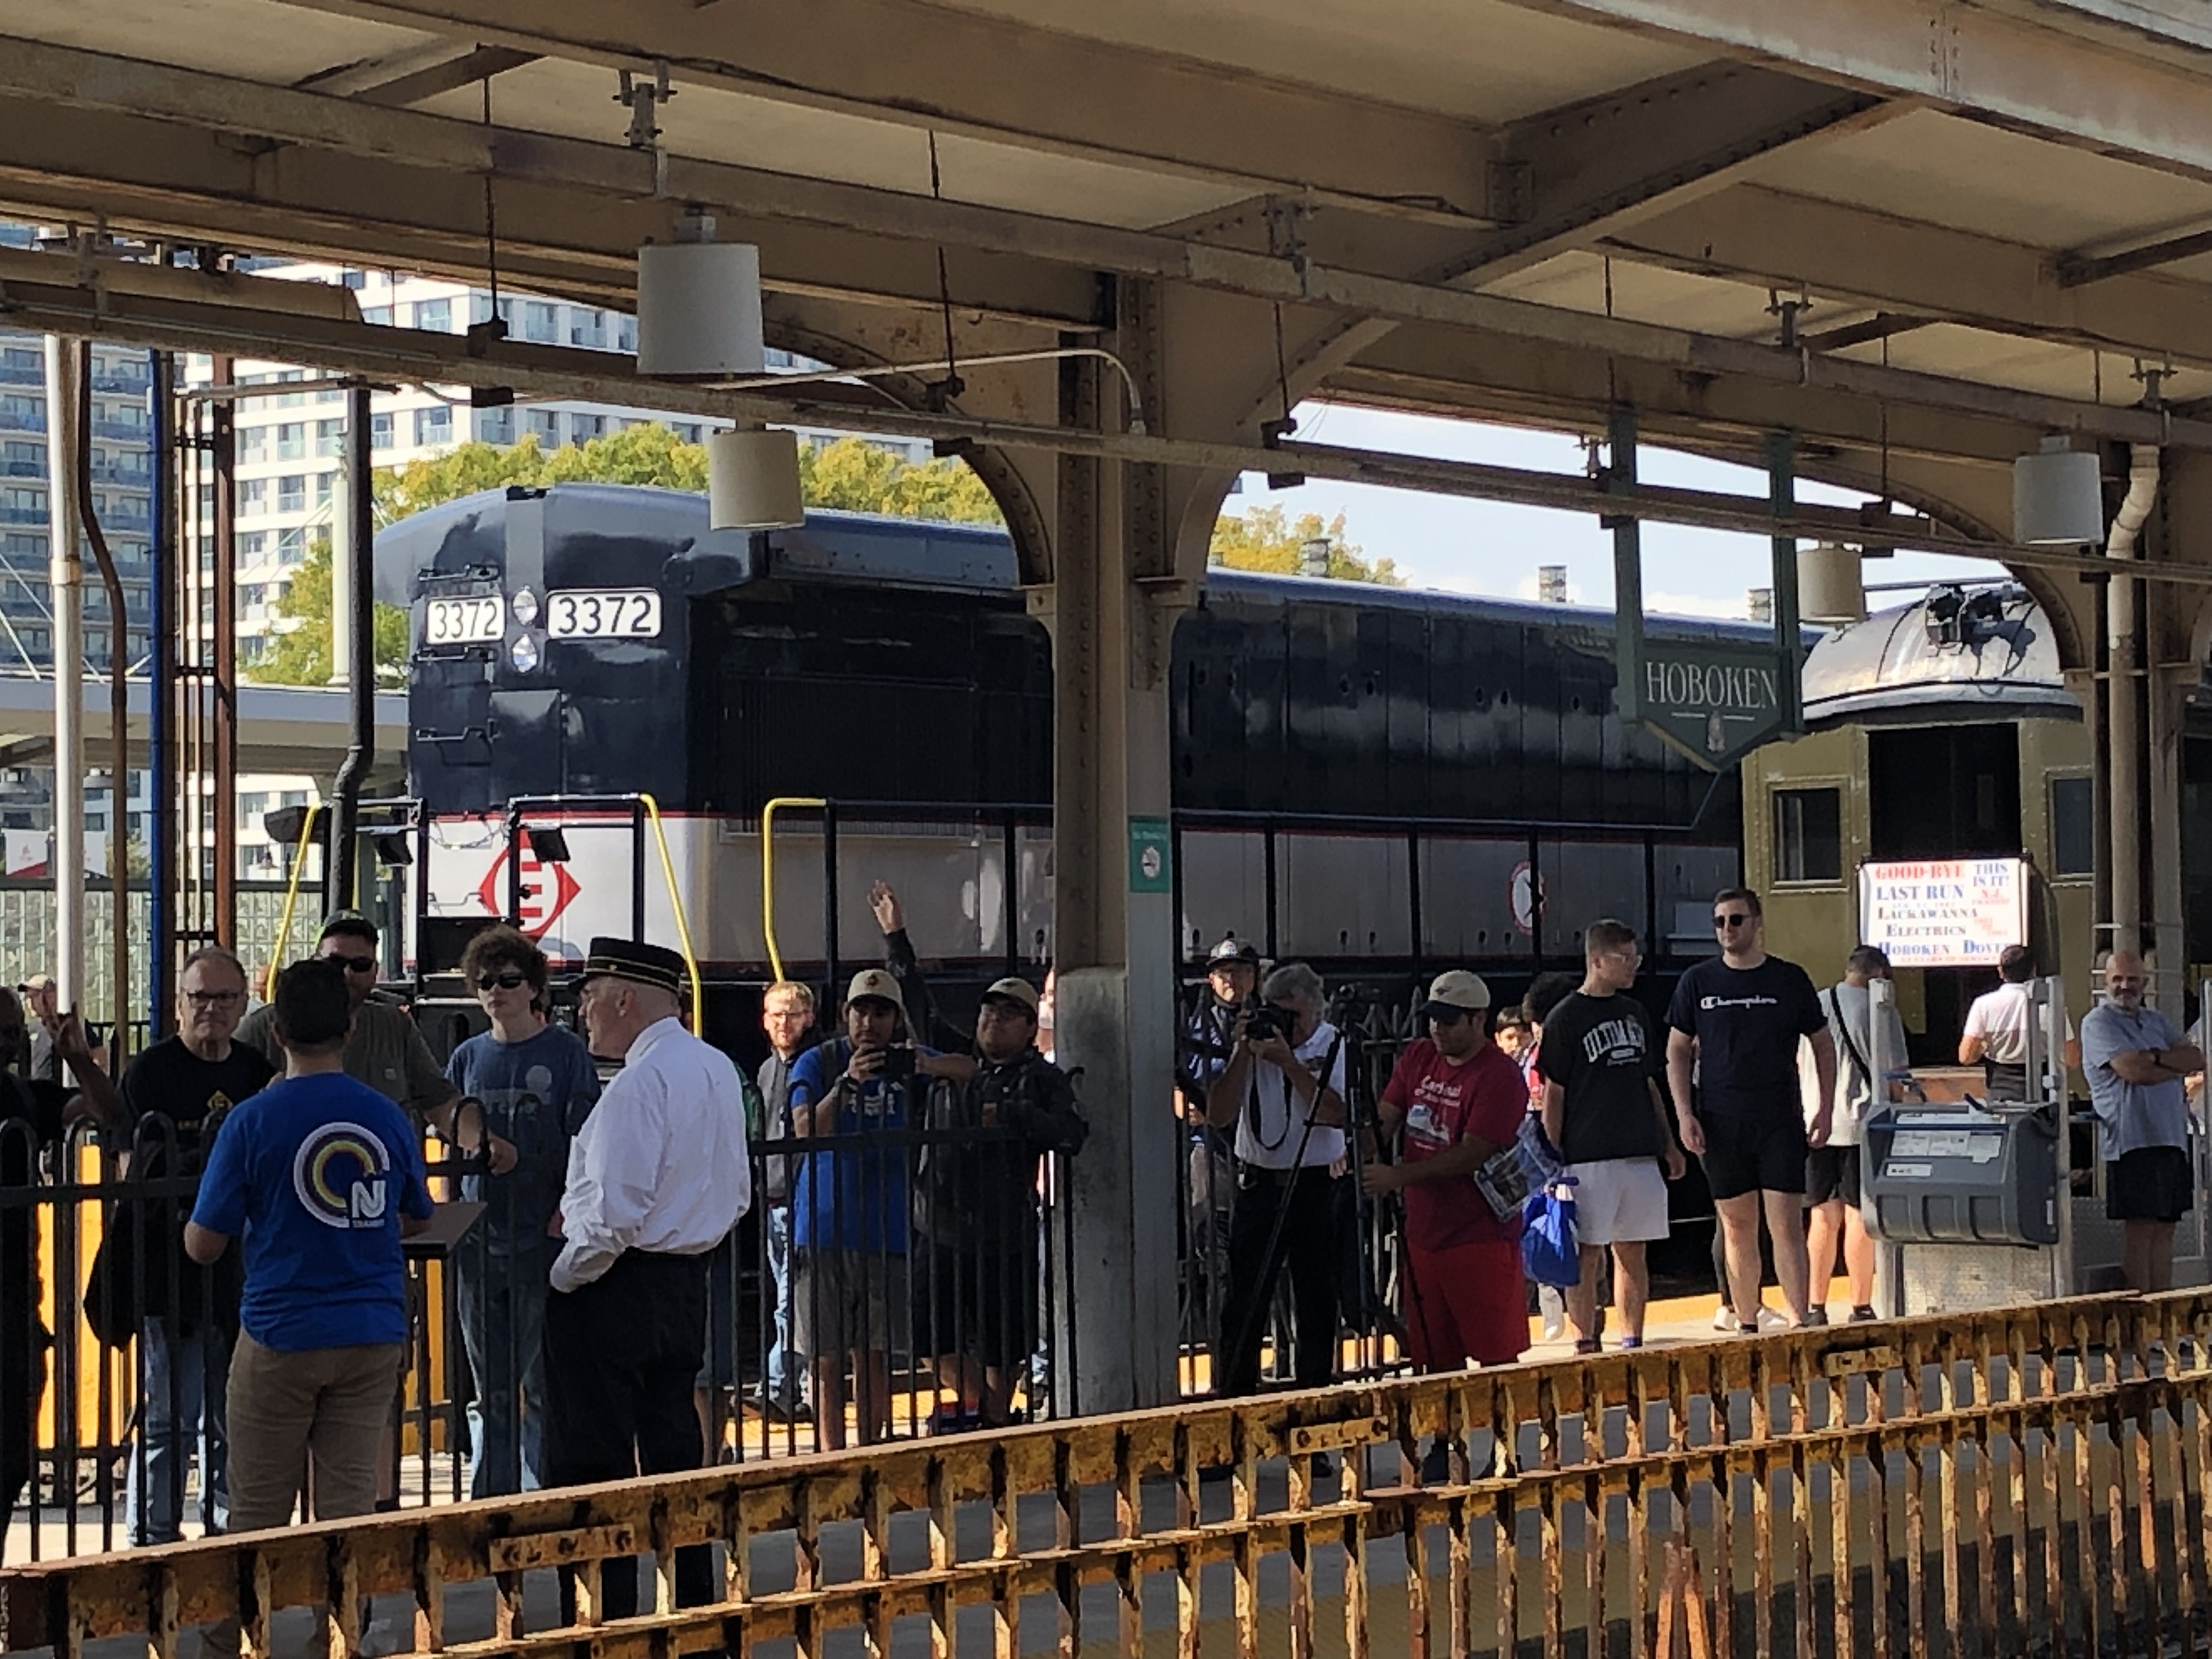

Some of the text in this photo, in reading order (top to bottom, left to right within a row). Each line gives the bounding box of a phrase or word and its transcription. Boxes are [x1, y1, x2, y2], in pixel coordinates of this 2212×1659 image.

[434, 600, 498, 639] 3372
[557, 595, 652, 635] 3372
[1646, 661, 1778, 709] HOBOKEN
[1875, 865, 1965, 879] GOOD-BYE
[1974, 863, 2008, 876] THIS
[1973, 876, 1986, 887] IS
[1876, 884, 1965, 900] LAST RUN
[1700, 994, 1778, 1009] Champion
